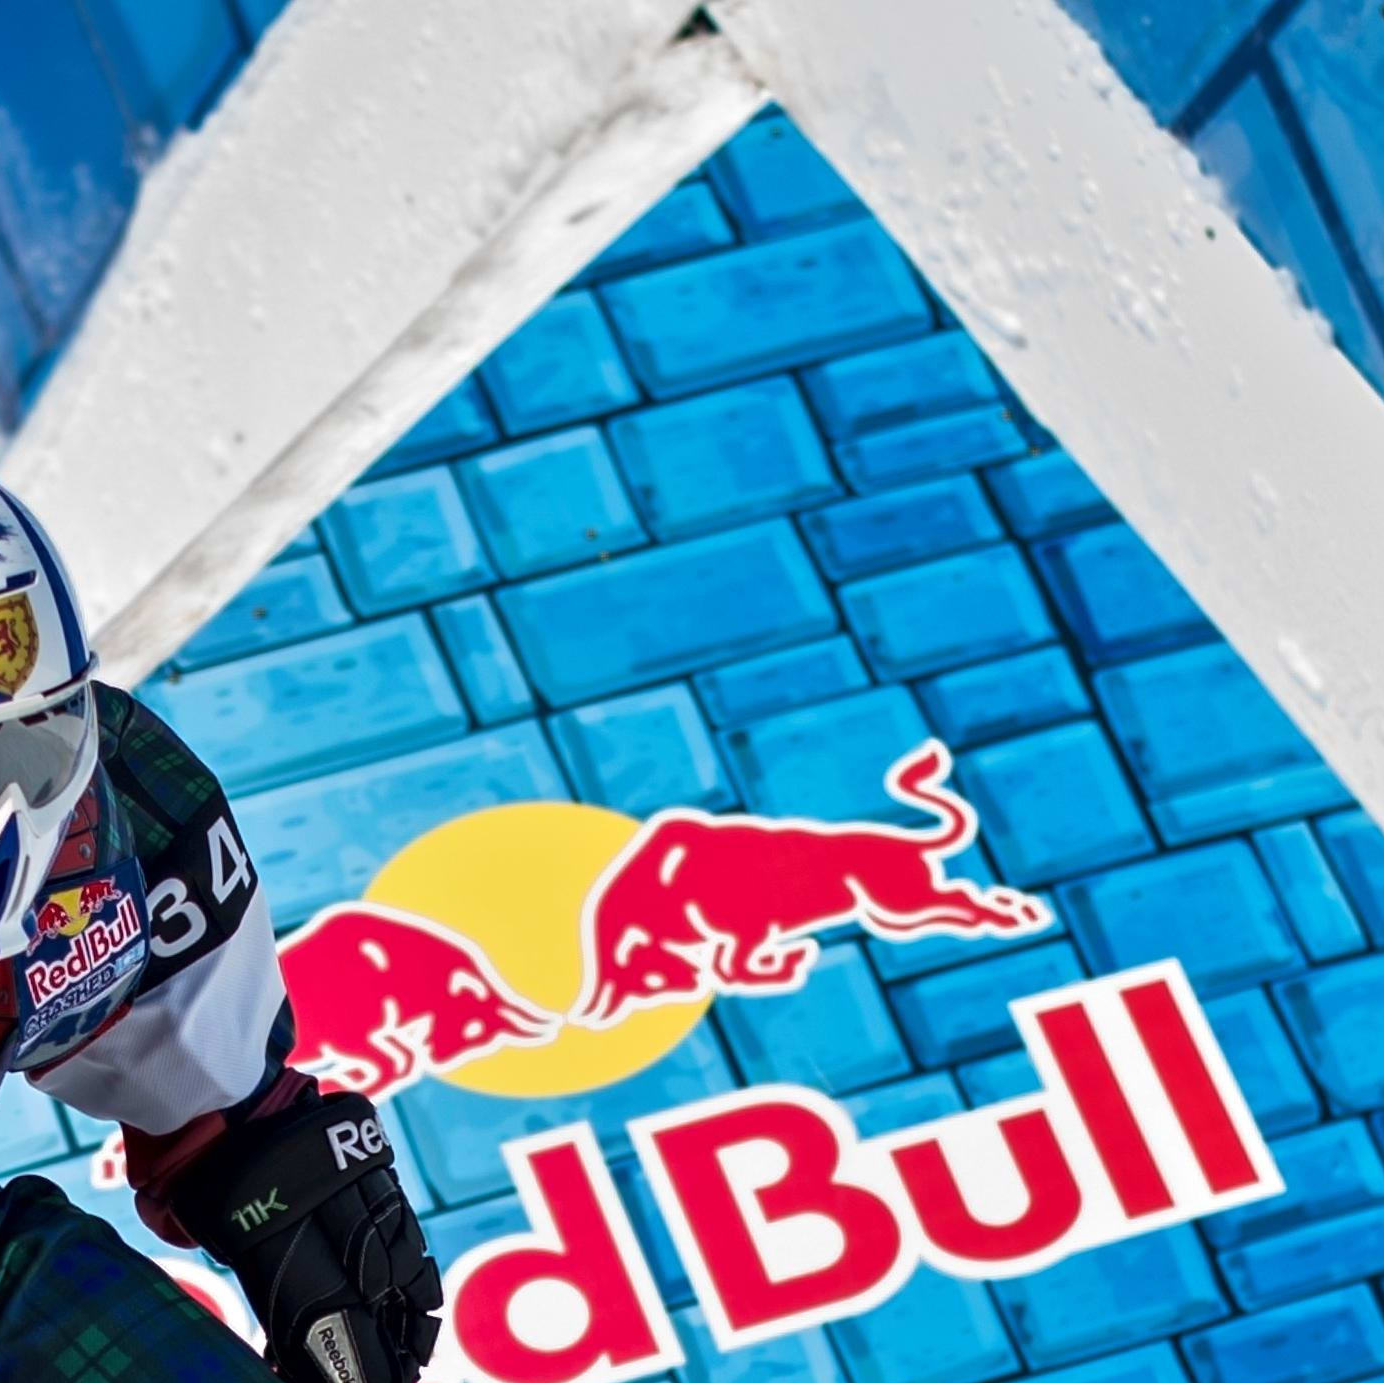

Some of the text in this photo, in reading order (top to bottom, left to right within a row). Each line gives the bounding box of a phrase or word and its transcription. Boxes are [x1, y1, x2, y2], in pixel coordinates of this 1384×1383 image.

[25, 892, 142, 1010] Red Bull
[642, 968, 1272, 1340] Bull
